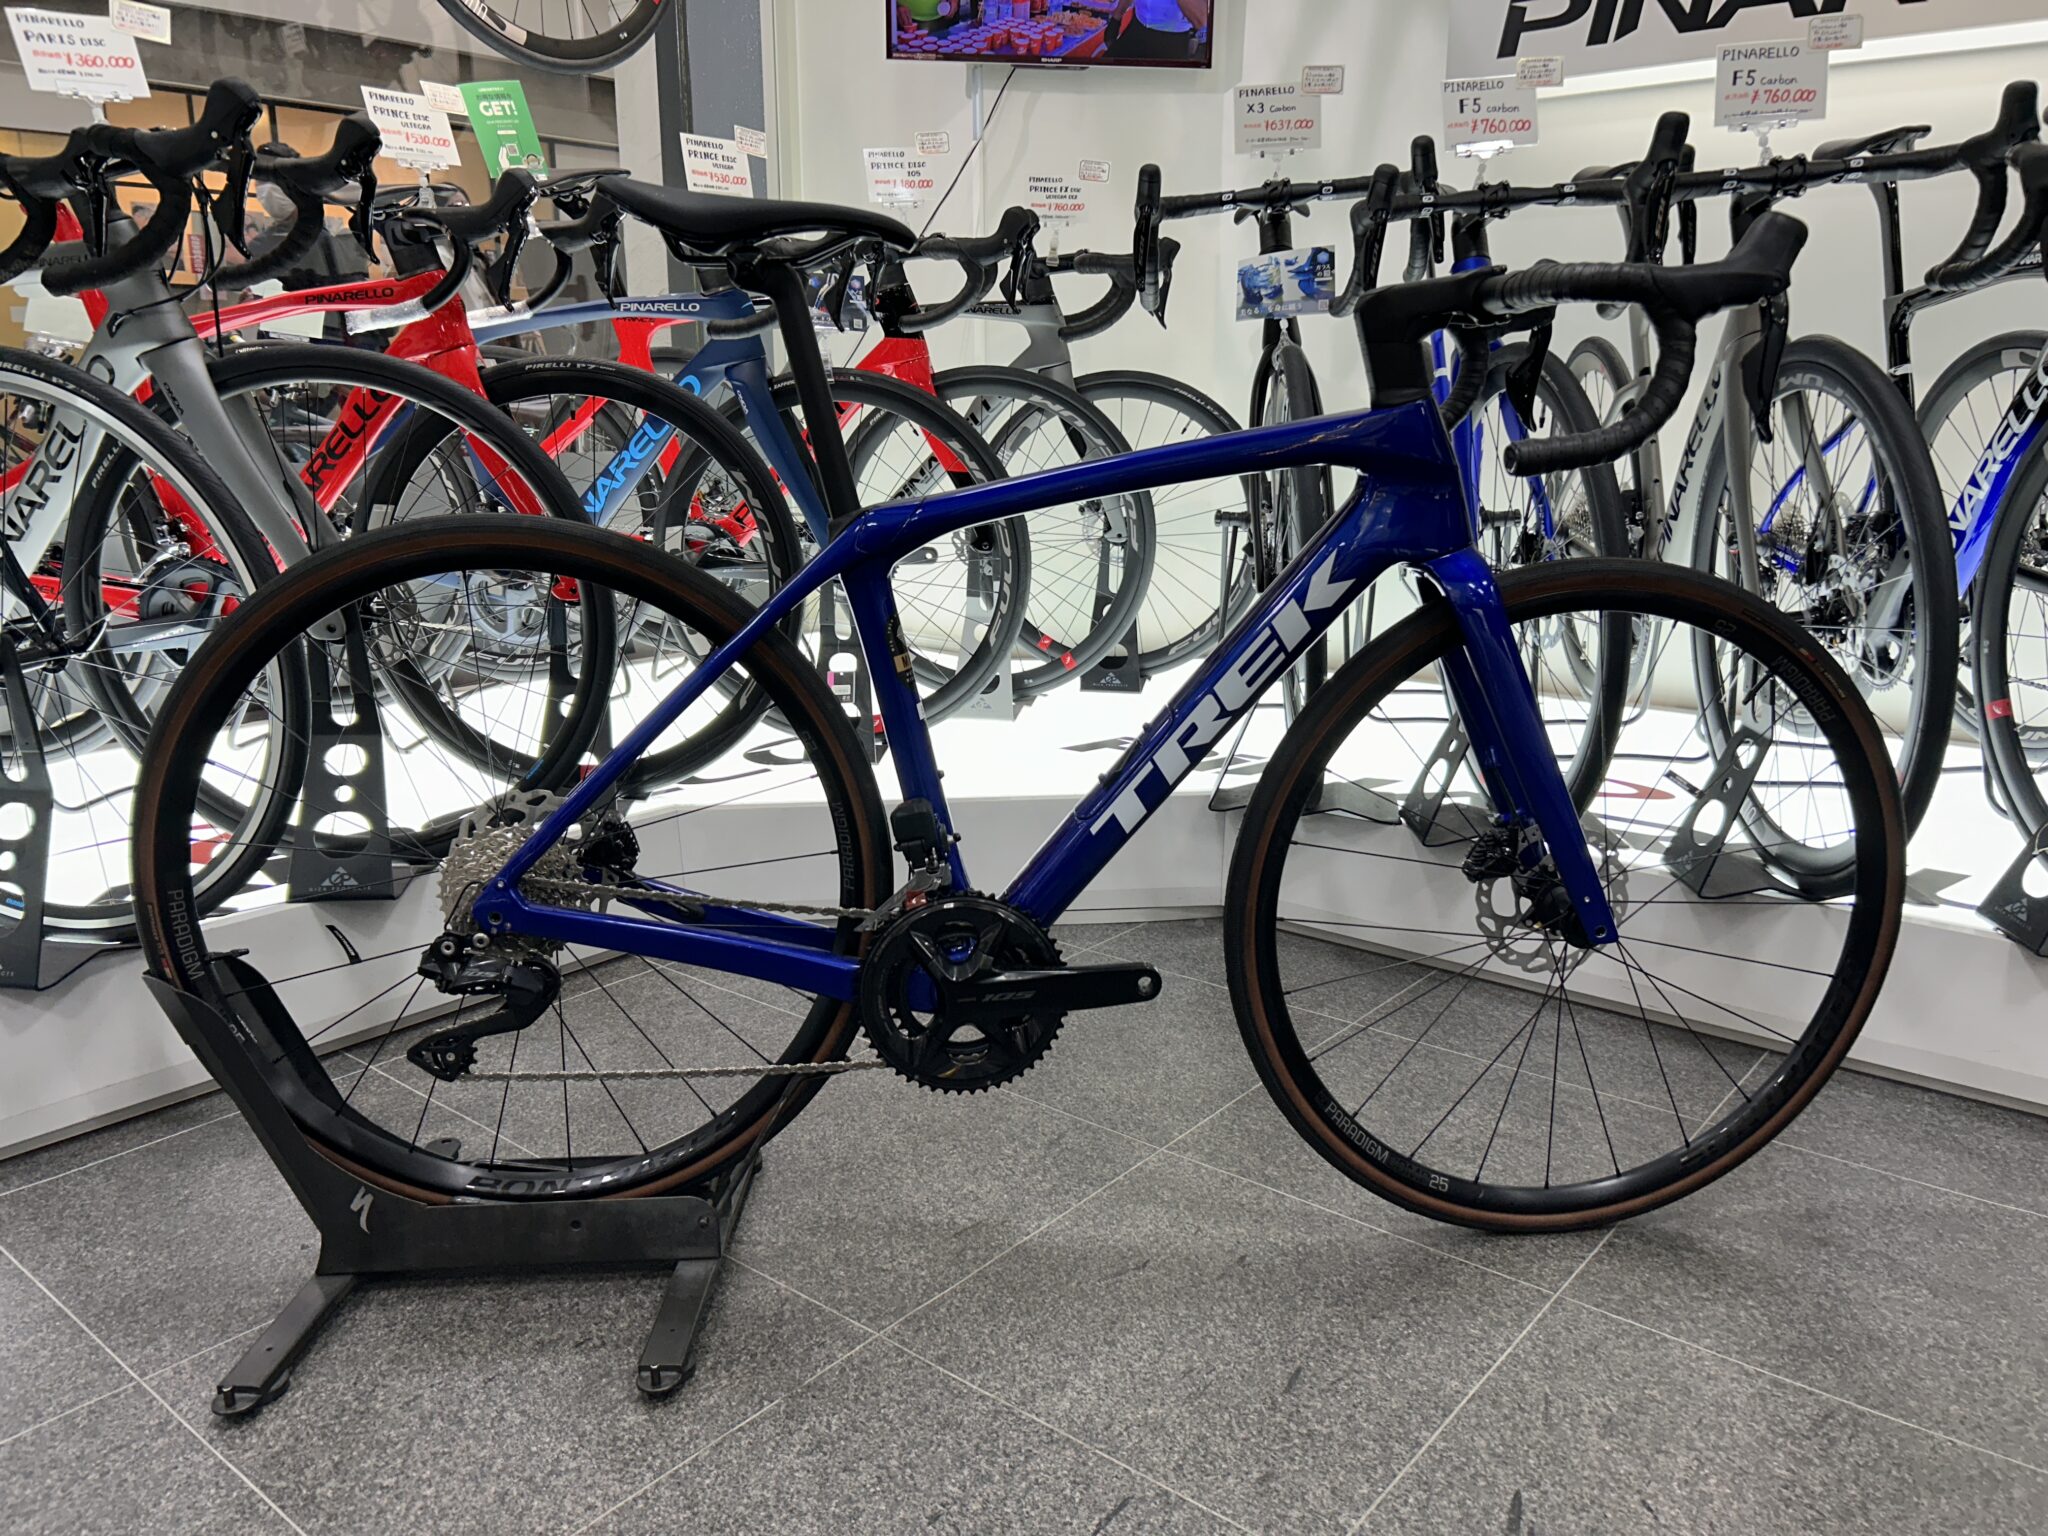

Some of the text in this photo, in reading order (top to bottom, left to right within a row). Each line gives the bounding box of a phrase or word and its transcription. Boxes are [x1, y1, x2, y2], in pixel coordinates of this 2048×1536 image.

[16, 13, 85, 28] PINARELLO
[24, 30, 106, 47] PARIS DISC
[1722, 46, 1800, 61] PINARELLO
[1732, 69, 1757, 87] F5
[1239, 86, 1295, 98] PINARELLO
[1443, 81, 1504, 93] PINARELLO
[369, 91, 414, 106] PINARELLO
[1459, 97, 1520, 114] F5 carbon
[373, 105, 430, 122] PRINCE DISC
[479, 100, 518, 117] GET!
[686, 138, 723, 150] PINARELLO
[688, 149, 737, 163] PRINCE DISC
[871, 162, 905, 170] PRINCE
[1029, 185, 1057, 193] PRINCE
[305, 287, 394, 304] PINARELLO
[620, 302, 700, 312] PINARELLO
[0, 361, 47, 378] IRELLI
[525, 361, 571, 371] PIRELLI
[1090, 547, 1357, 836] TREK
[1772, 654, 1837, 723] PARADIGM
[832, 801, 855, 890] PARADIGM
[168, 889, 205, 981] PARADIGM
[1324, 1103, 1449, 1193] PARADIGM 25
